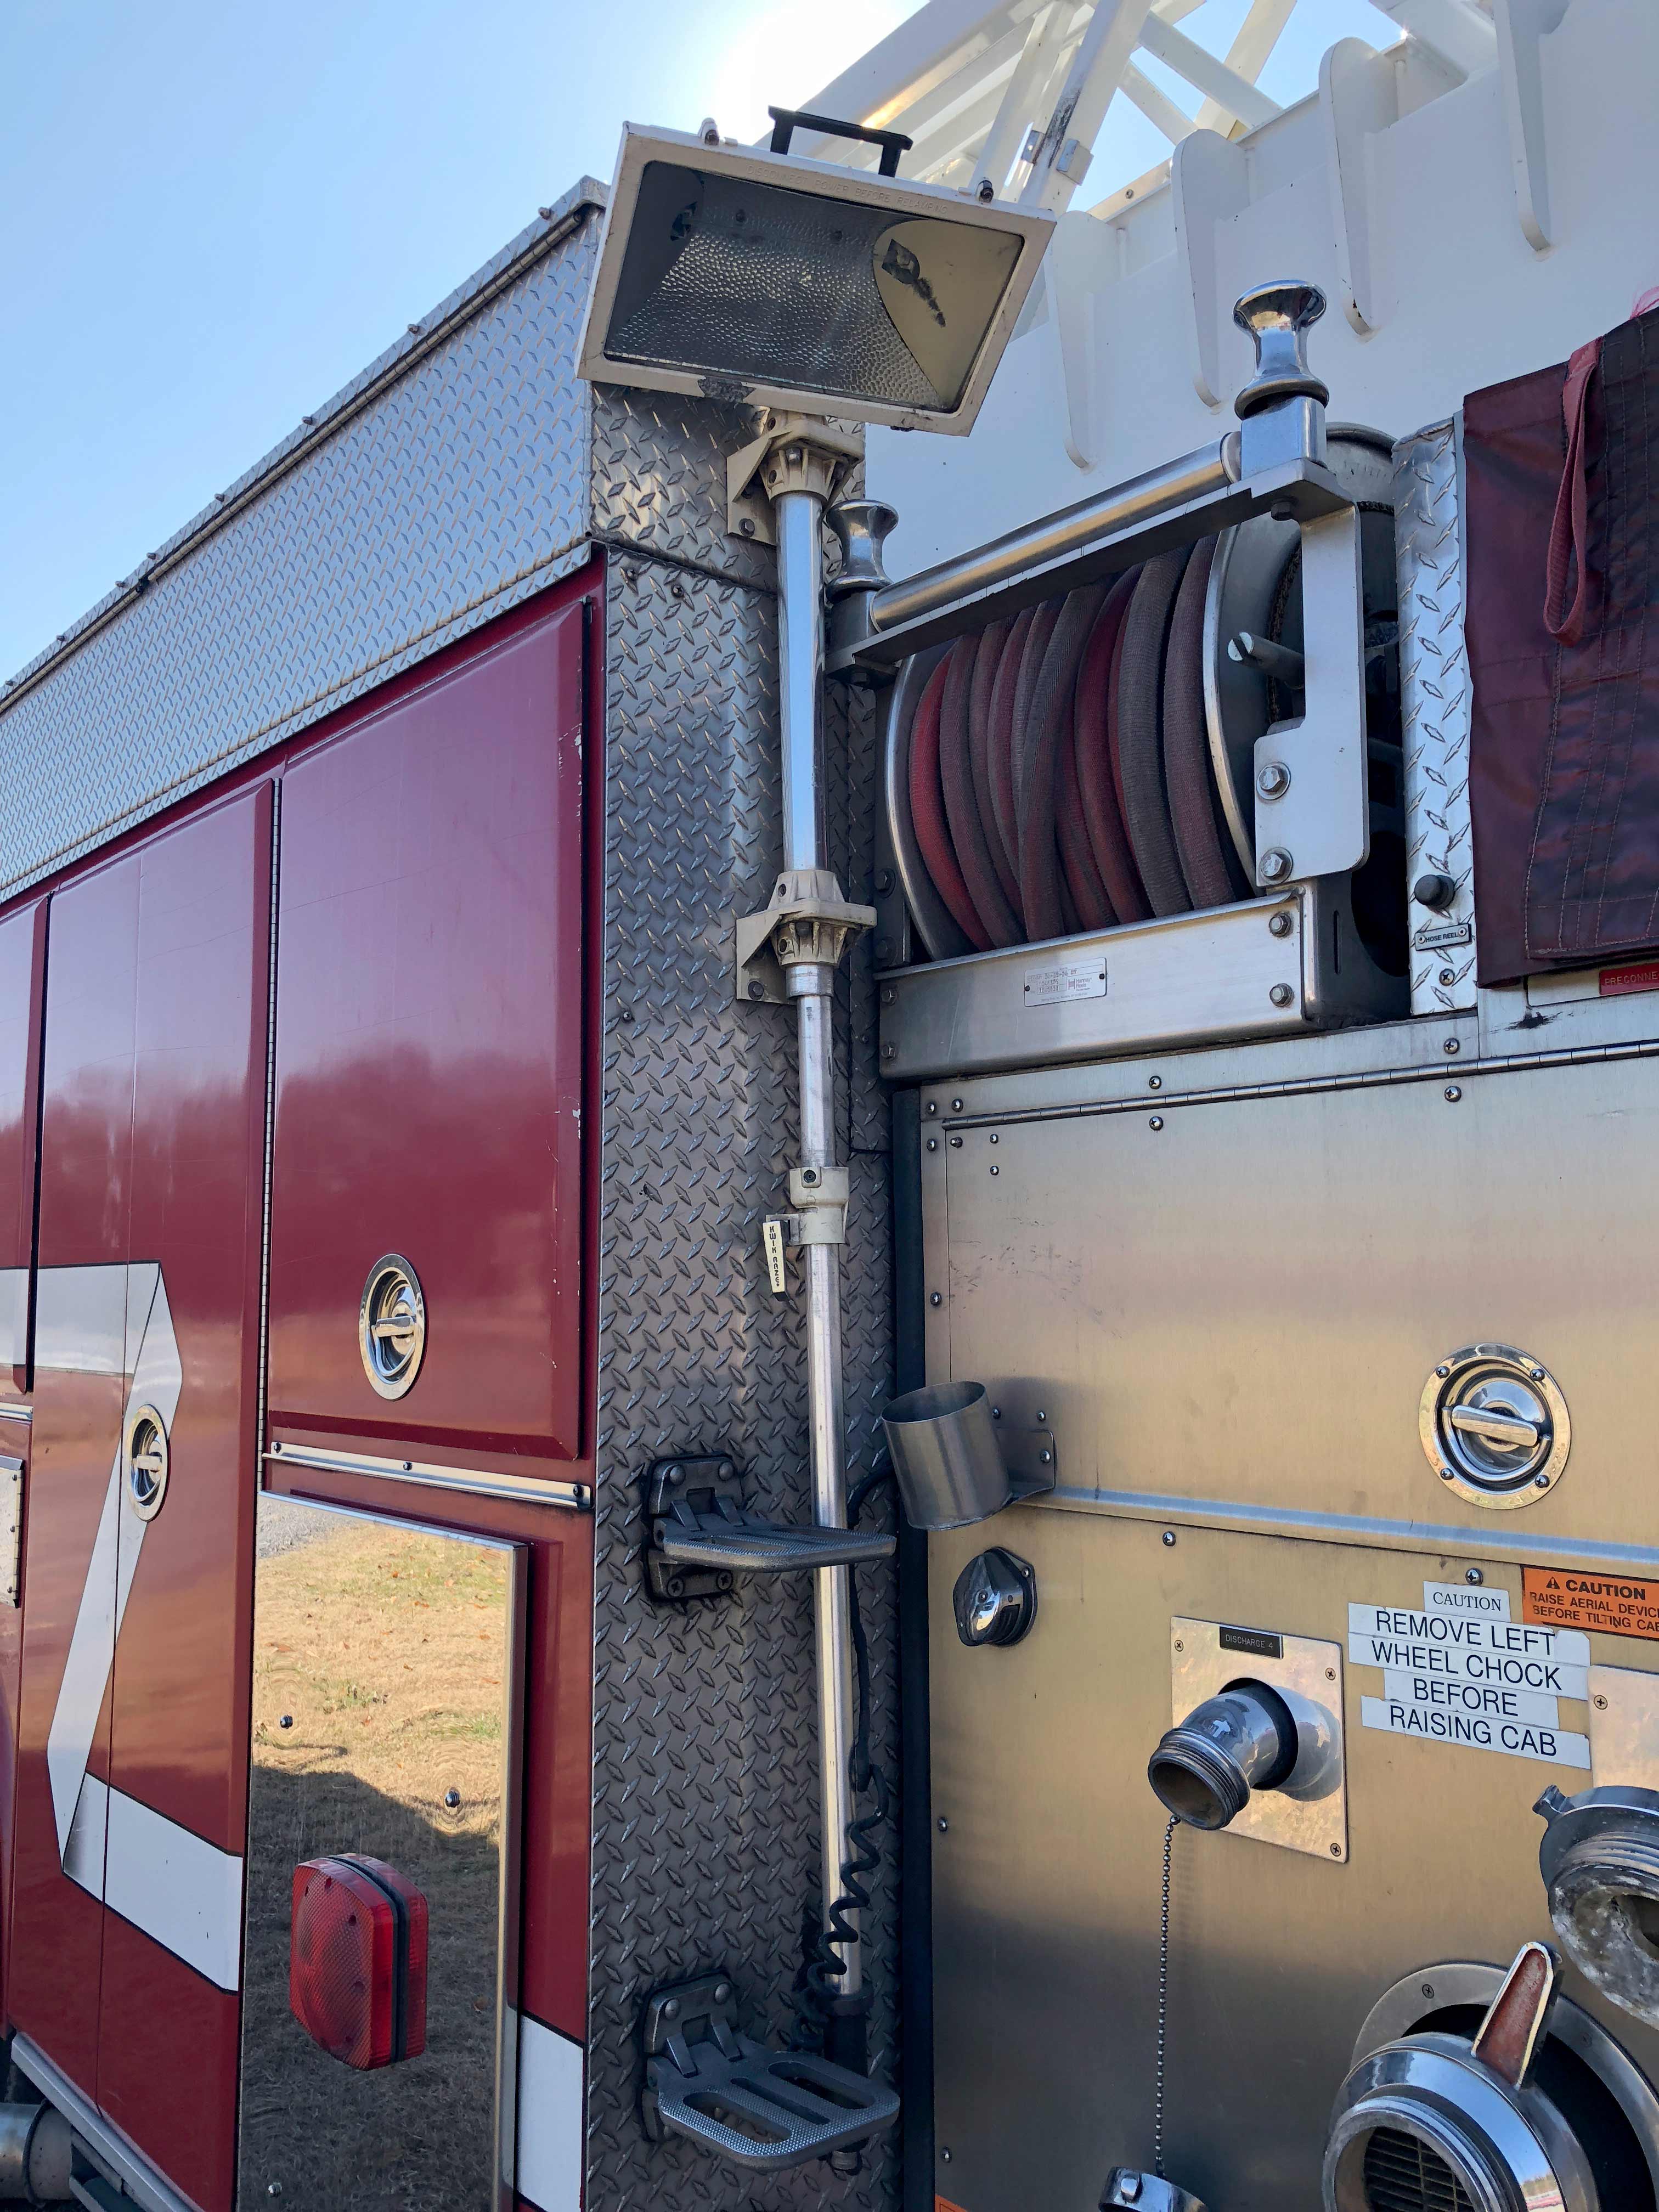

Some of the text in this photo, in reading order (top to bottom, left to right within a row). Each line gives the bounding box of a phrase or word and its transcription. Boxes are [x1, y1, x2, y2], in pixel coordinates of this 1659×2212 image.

[814, 178, 849, 193] POWER
[855, 187, 892, 203] BEFORE
[1426, 934, 1442, 943] HOSE
[1433, 1592, 1502, 1611] CAUTION
[1566, 1579, 1646, 1600] CAUTION
[1530, 1592, 1659, 1617] RAISE AERIAL DEVIC
[1533, 1605, 1581, 1621] BEFORE
[1585, 1612, 1631, 1628] TILTING
[1226, 1634, 1266, 1649] DISCHARGE
[1376, 1610, 1555, 1656] REMOVE LEFT
[1372, 1639, 1562, 1691] WHEEL CHOCK
[1413, 1677, 1519, 1717] BEFORE
[1390, 1705, 1557, 1757] RAISING CAB
